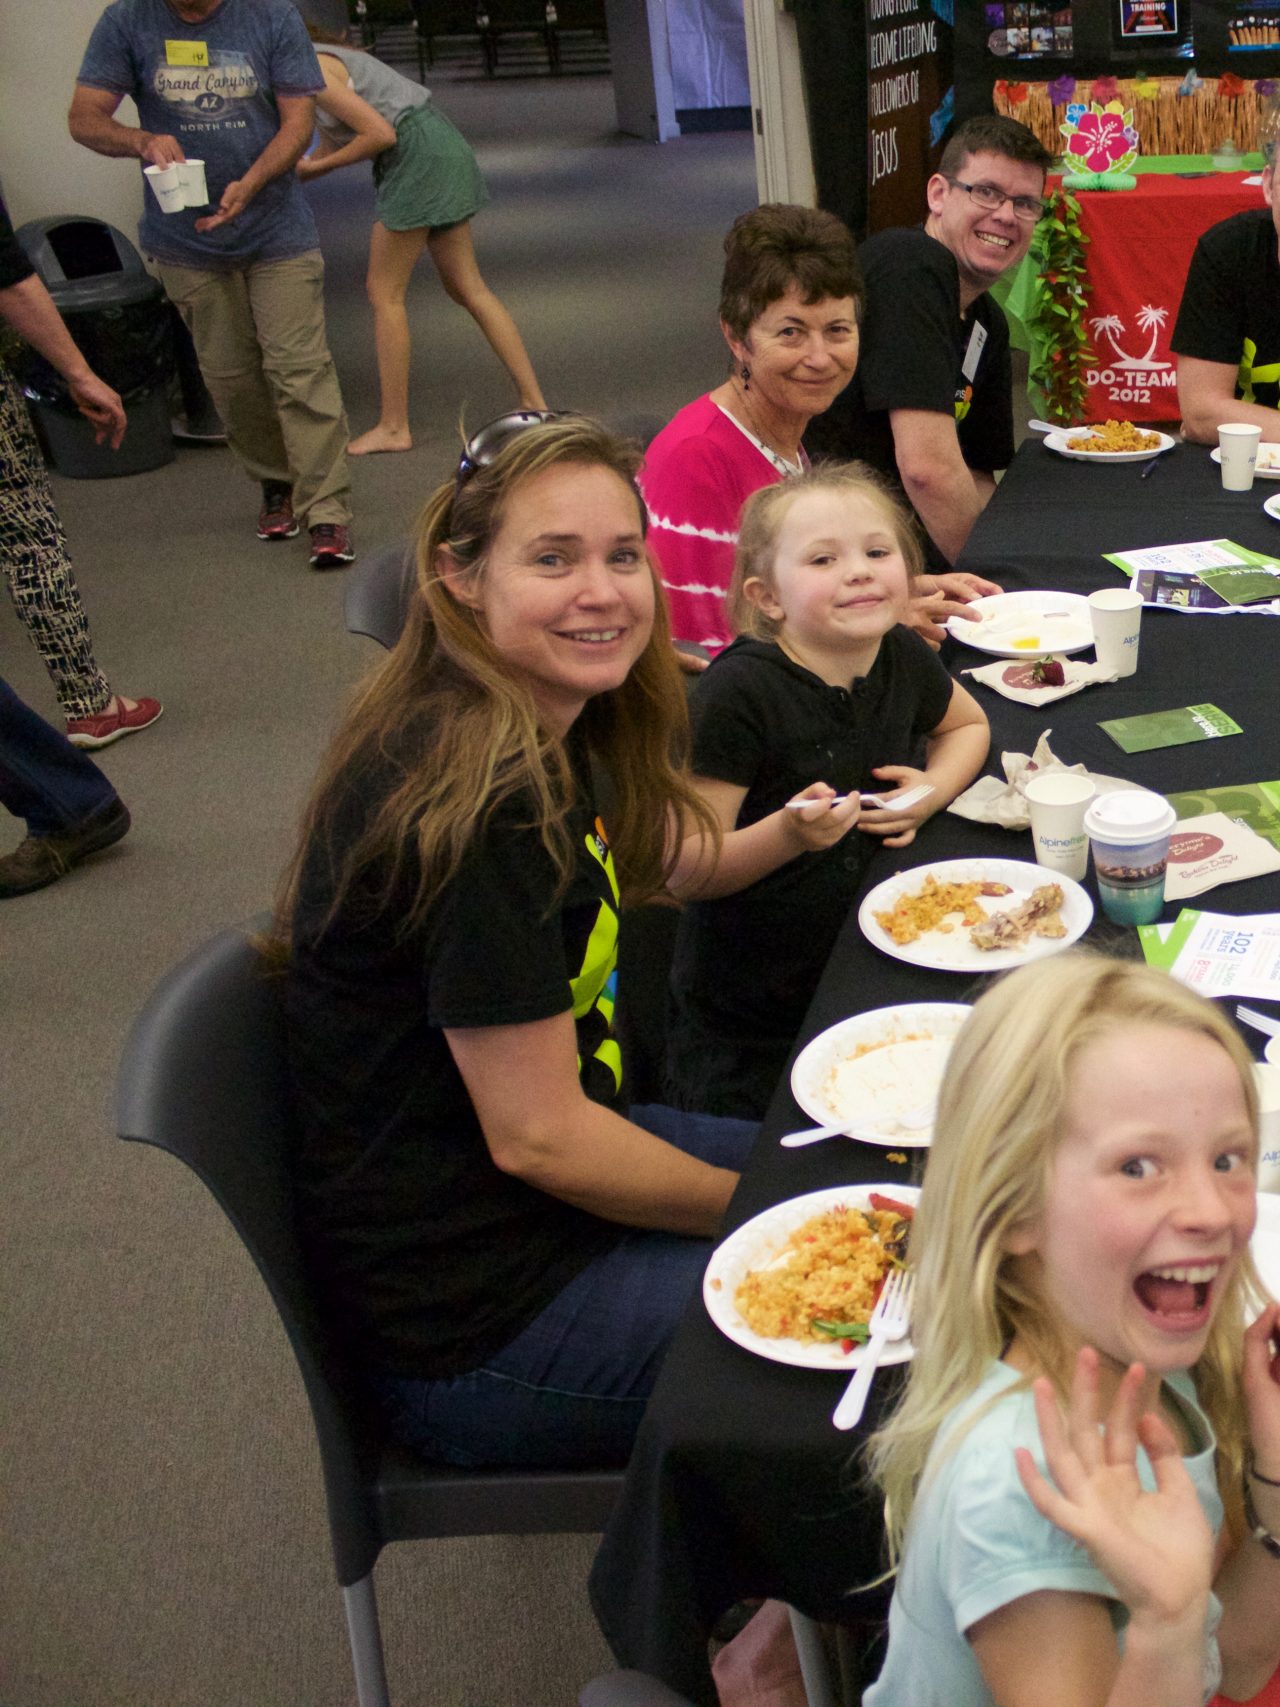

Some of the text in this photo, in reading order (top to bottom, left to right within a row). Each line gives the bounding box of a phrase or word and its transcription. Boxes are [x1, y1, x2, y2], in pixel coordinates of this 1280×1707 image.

[1131, 2, 1166, 12] TRAINING
[158, 73, 201, 93] Grand
[910, 70, 920, 105] OF
[200, 96, 218, 109] AZ
[180, 120, 247, 132] NORTH RIM
[871, 127, 899, 187] JESUS
[1086, 369, 1177, 387] DO-TEAM
[1108, 387, 1151, 404] 2012
[1217, 929, 1236, 952] years
[1228, 931, 1254, 954] 102
